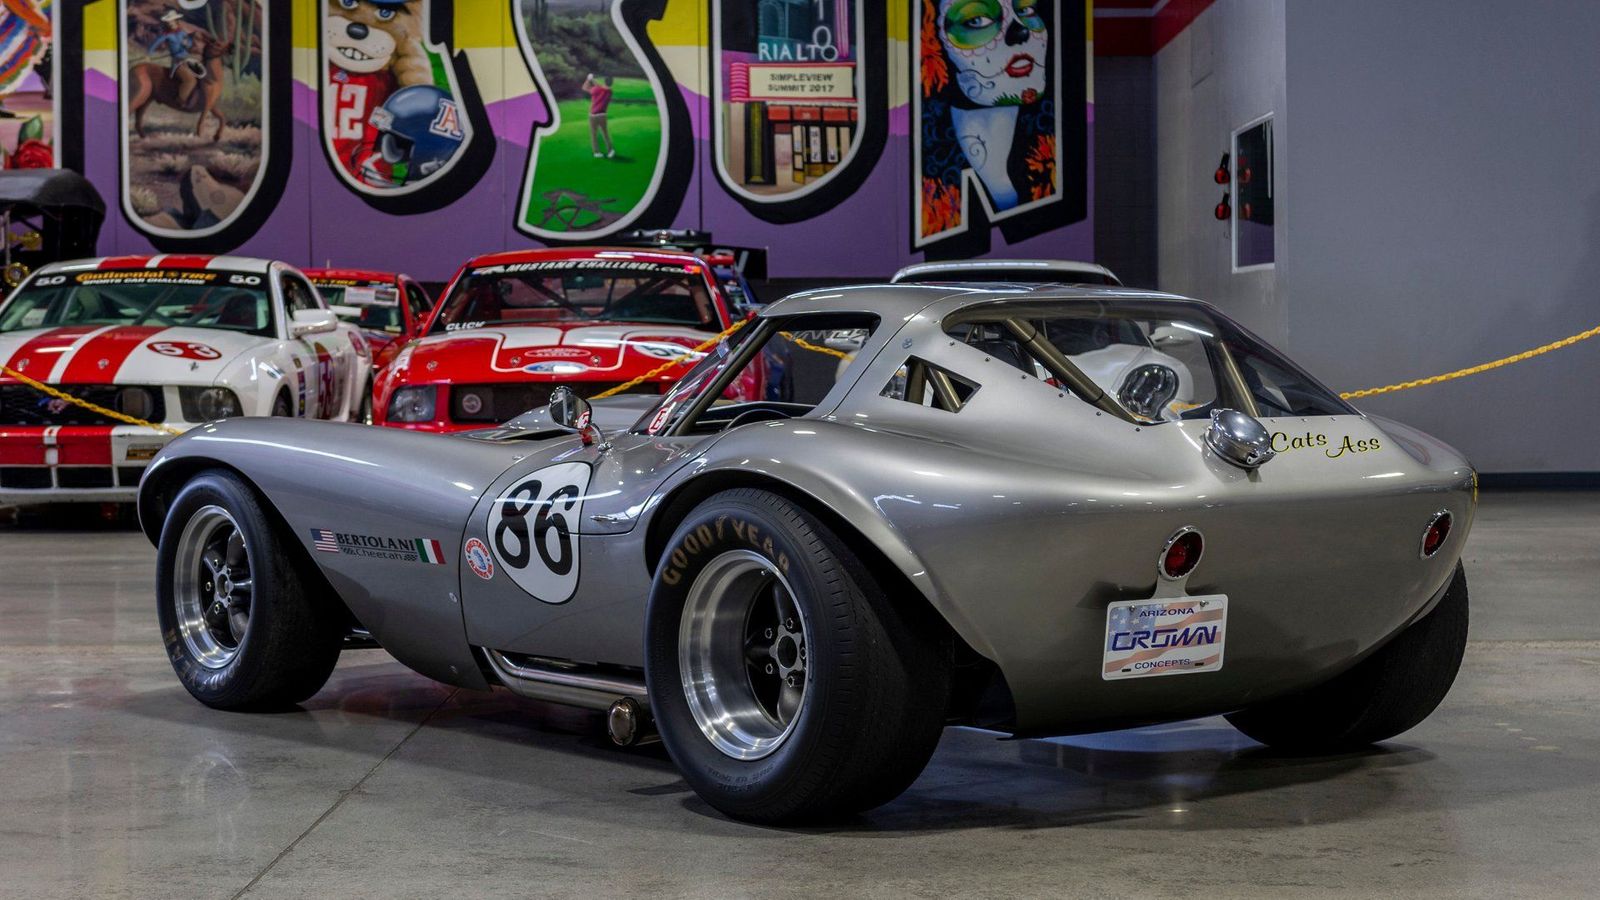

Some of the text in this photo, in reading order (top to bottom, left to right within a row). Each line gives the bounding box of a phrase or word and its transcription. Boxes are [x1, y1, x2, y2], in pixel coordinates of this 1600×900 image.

[759, 43, 838, 61] RIALTO
[770, 73, 833, 81] SIMPLEVIEW
[768, 84, 834, 92] SUMMIT 2017
[505, 260, 577, 273] MUSTANG
[75, 270, 217, 282] Continental TIRE
[82, 277, 122, 285] SPORTS
[146, 277, 206, 285] CHALLENGE
[445, 321, 486, 331] CLICK
[154, 343, 217, 358] 53
[1270, 431, 1381, 458] Cats Ass
[495, 480, 579, 576] 86
[335, 533, 416, 551] BERTOLANI
[355, 548, 403, 561] Cheetah
[1139, 607, 1195, 618] ARIZONA
[1111, 625, 1218, 652] CROWN
[1134, 658, 1191, 670] CONCEPTS
